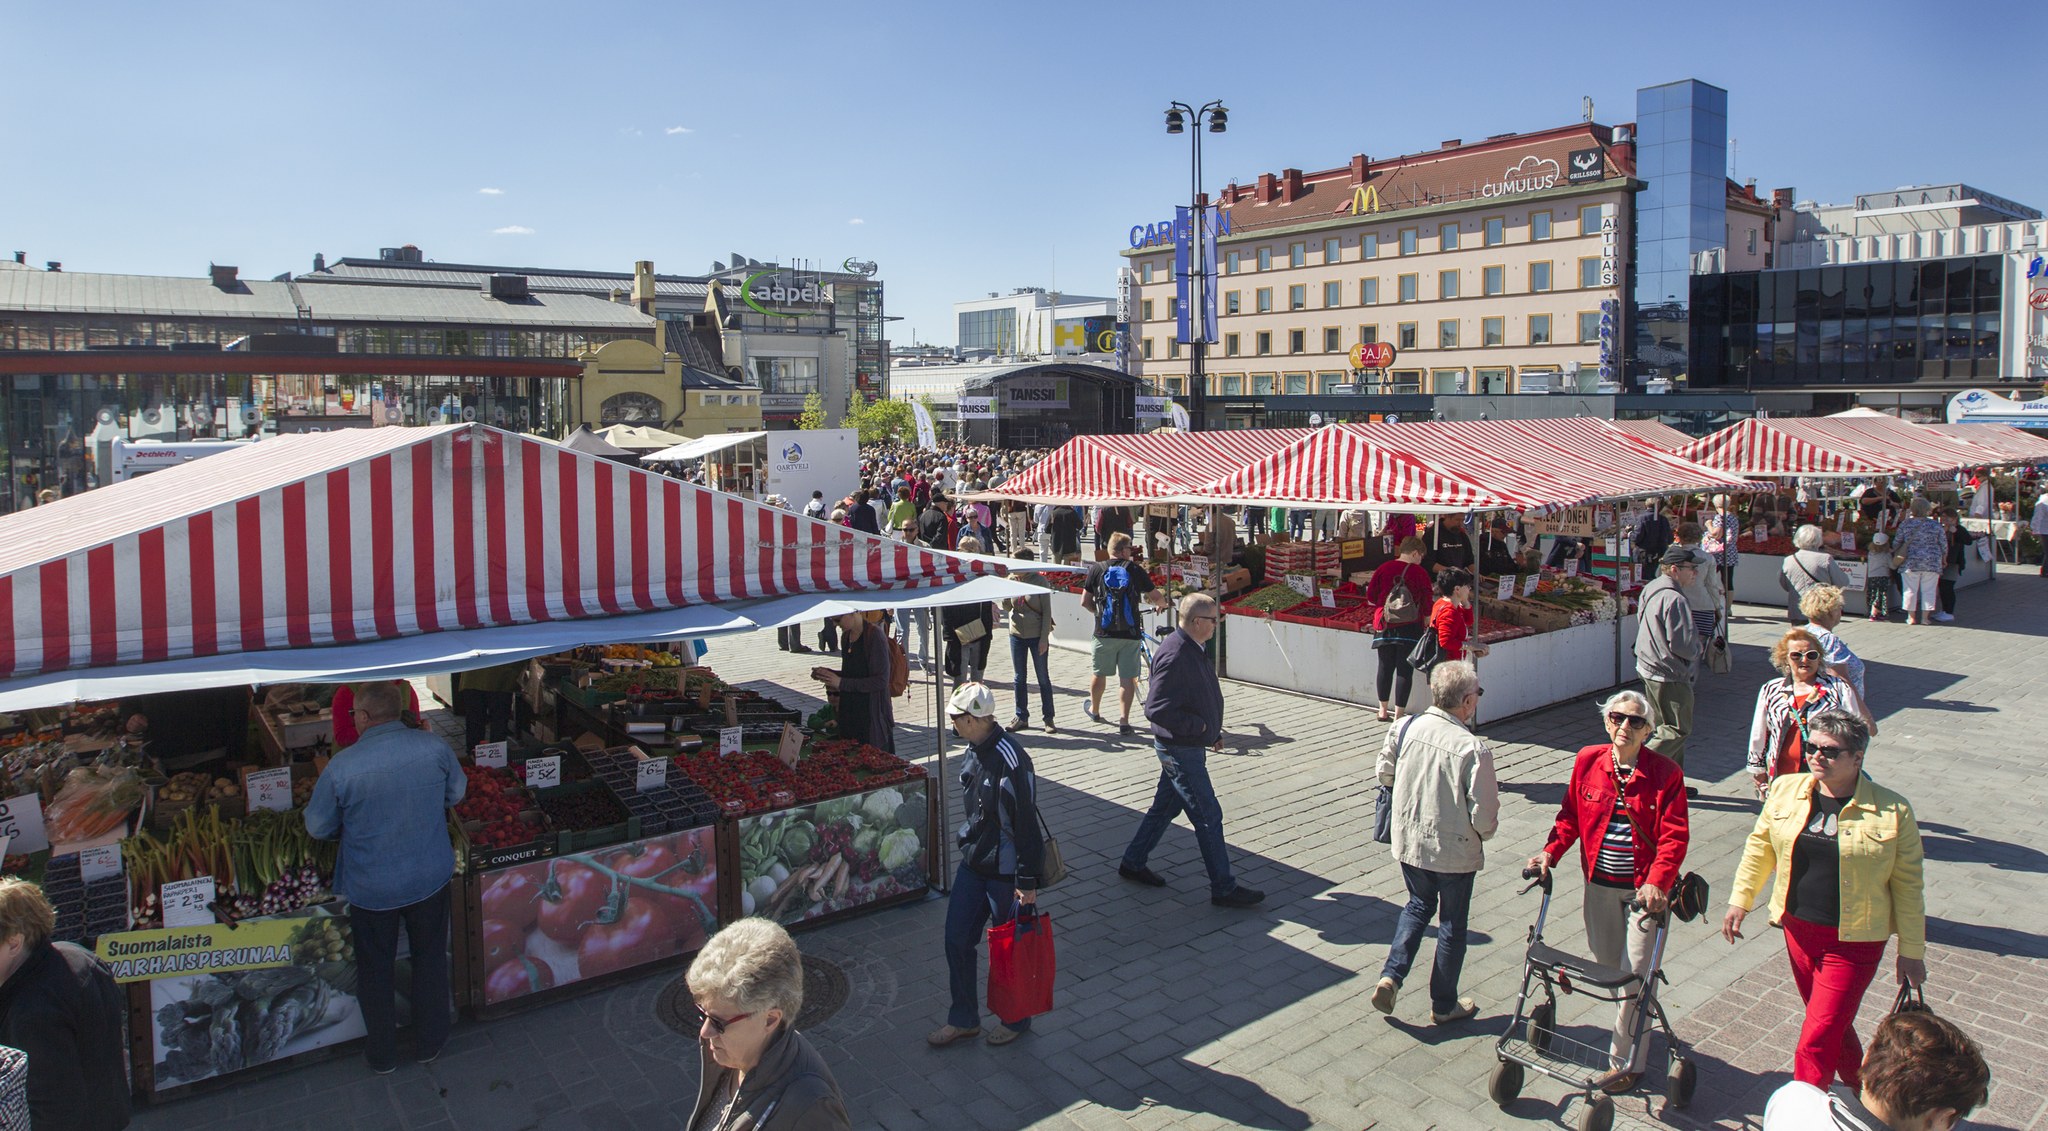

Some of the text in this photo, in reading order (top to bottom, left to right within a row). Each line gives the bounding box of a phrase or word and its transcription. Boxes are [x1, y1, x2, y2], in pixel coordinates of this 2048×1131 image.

[1569, 169, 1601, 180] GRILLSSON
[1482, 174, 1554, 198] CUMULUS
[1602, 218, 1612, 284] ATLAS
[756, 281, 827, 306] aapeli
[1351, 346, 1390, 360] APAJA
[1010, 388, 1055, 401] TANSSII
[959, 404, 990, 413] TANSSII
[1136, 404, 1164, 412] TANSSII
[777, 463, 809, 472] QARTVELI
[491, 849, 537, 864] CONQUET
[164, 878, 213, 891] SUOMALAINEN
[108, 934, 212, 957] Suomalaista
